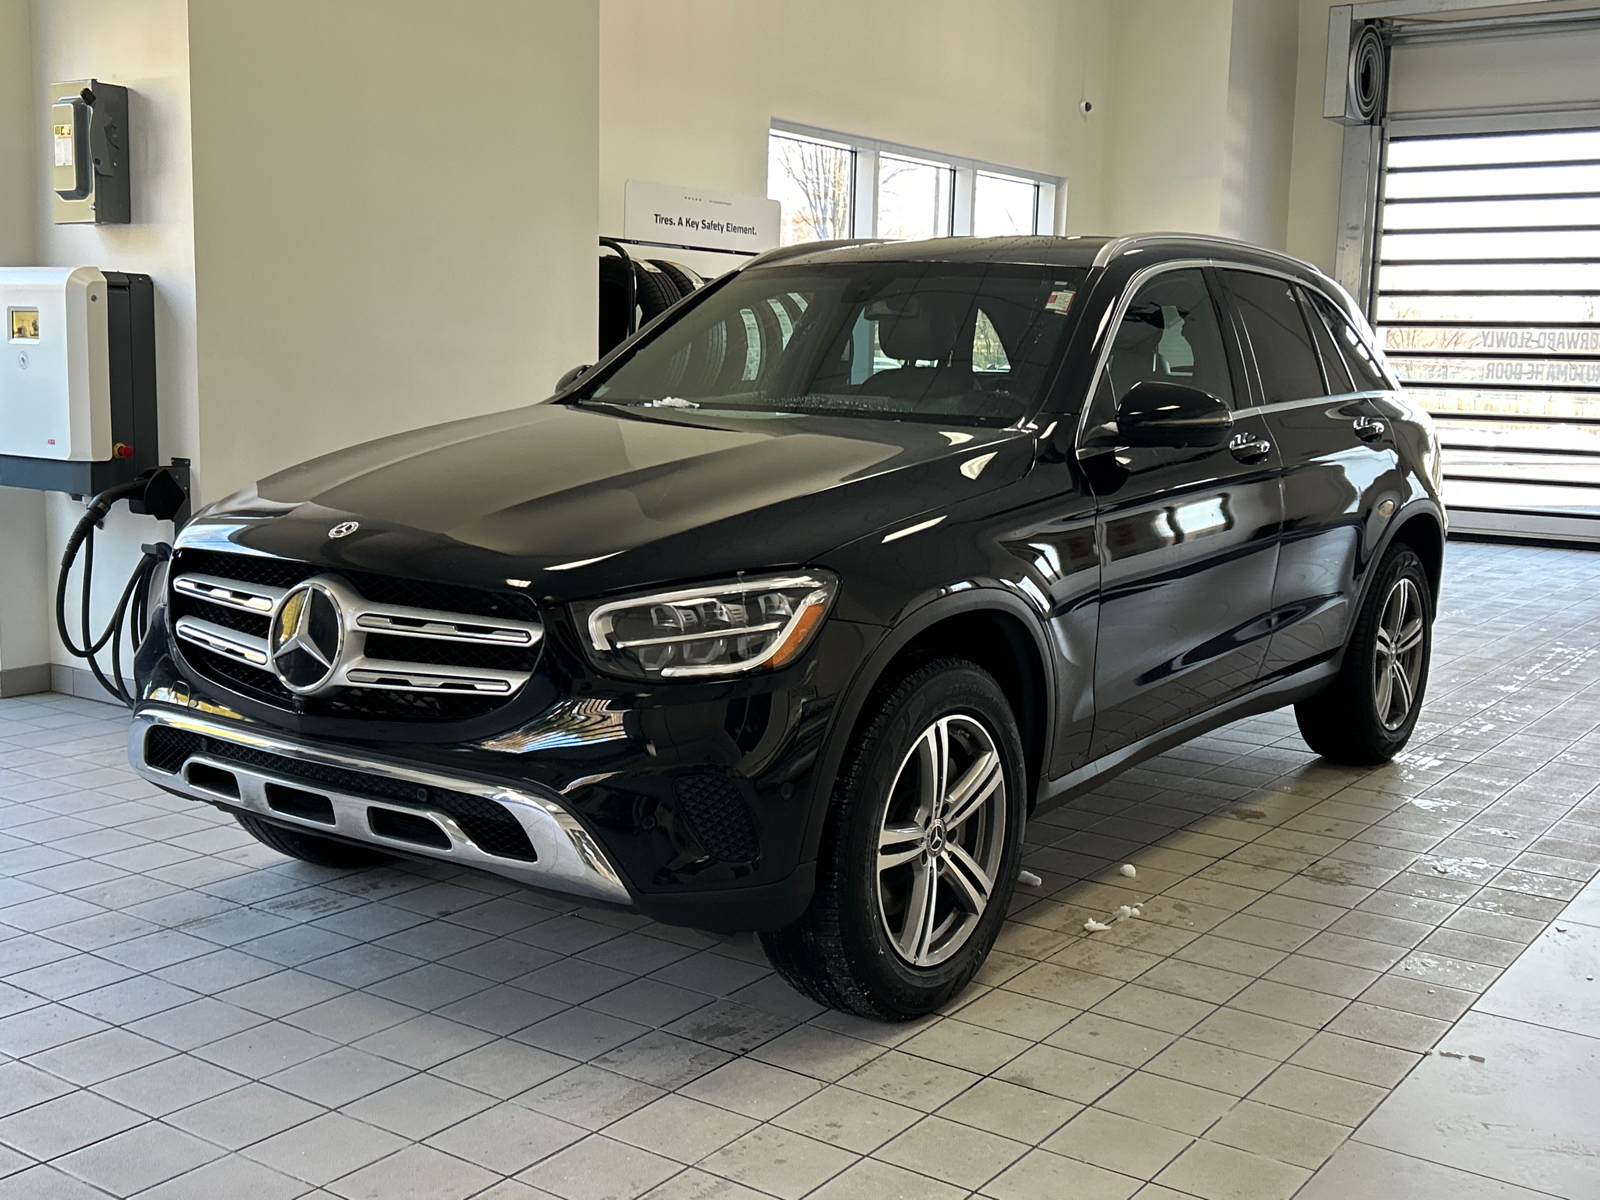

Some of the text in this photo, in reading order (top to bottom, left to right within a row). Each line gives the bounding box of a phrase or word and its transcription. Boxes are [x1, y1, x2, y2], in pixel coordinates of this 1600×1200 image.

[654, 213, 757, 236] Tires. A Key Safety Element.
